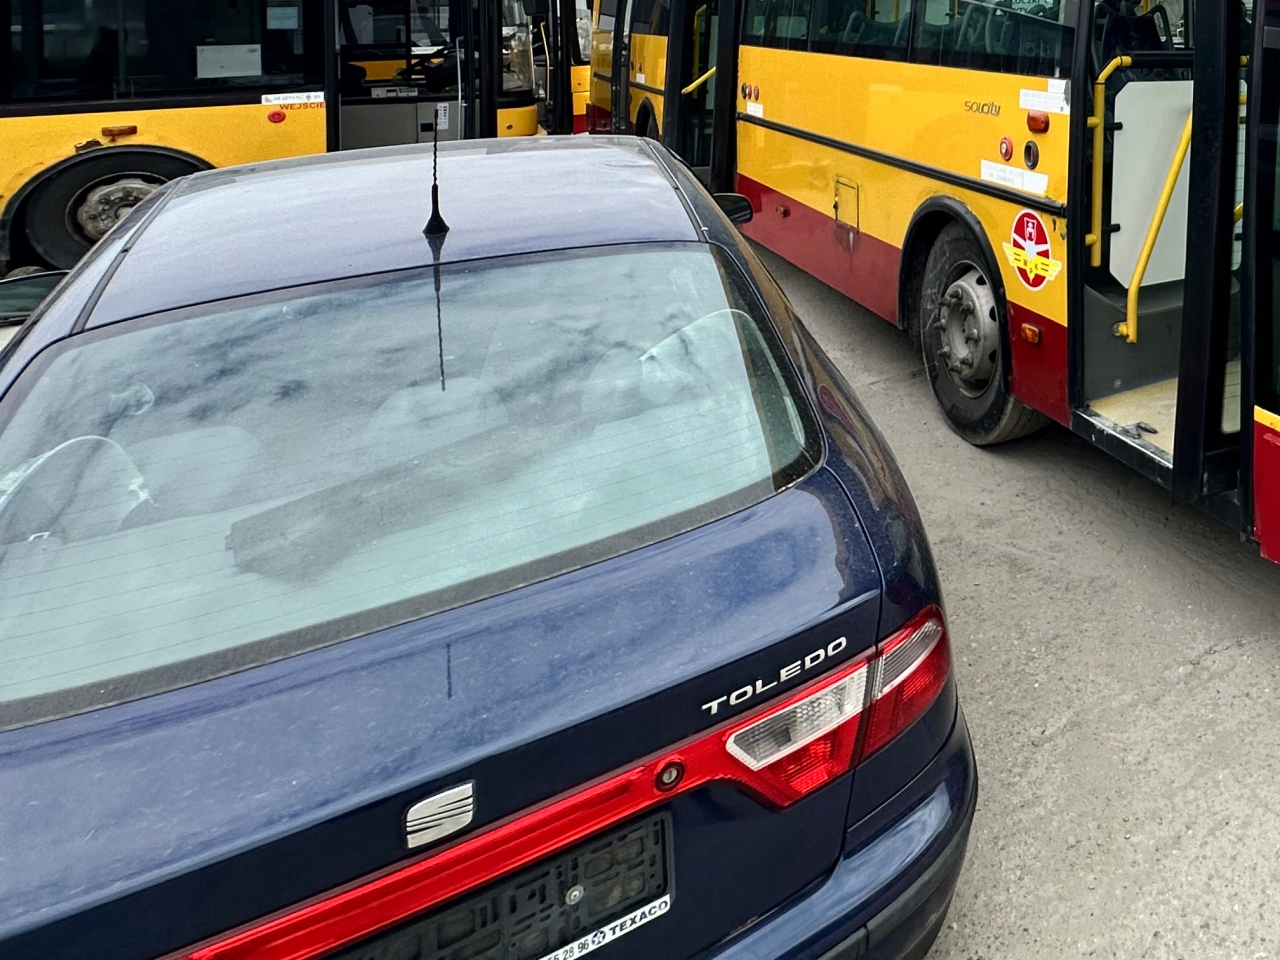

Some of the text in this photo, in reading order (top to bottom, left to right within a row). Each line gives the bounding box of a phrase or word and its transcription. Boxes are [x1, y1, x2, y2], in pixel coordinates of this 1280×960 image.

[701, 636, 847, 715] TOLEDO
[577, 939, 589, 954] 96
[609, 900, 668, 936] TEXACO
